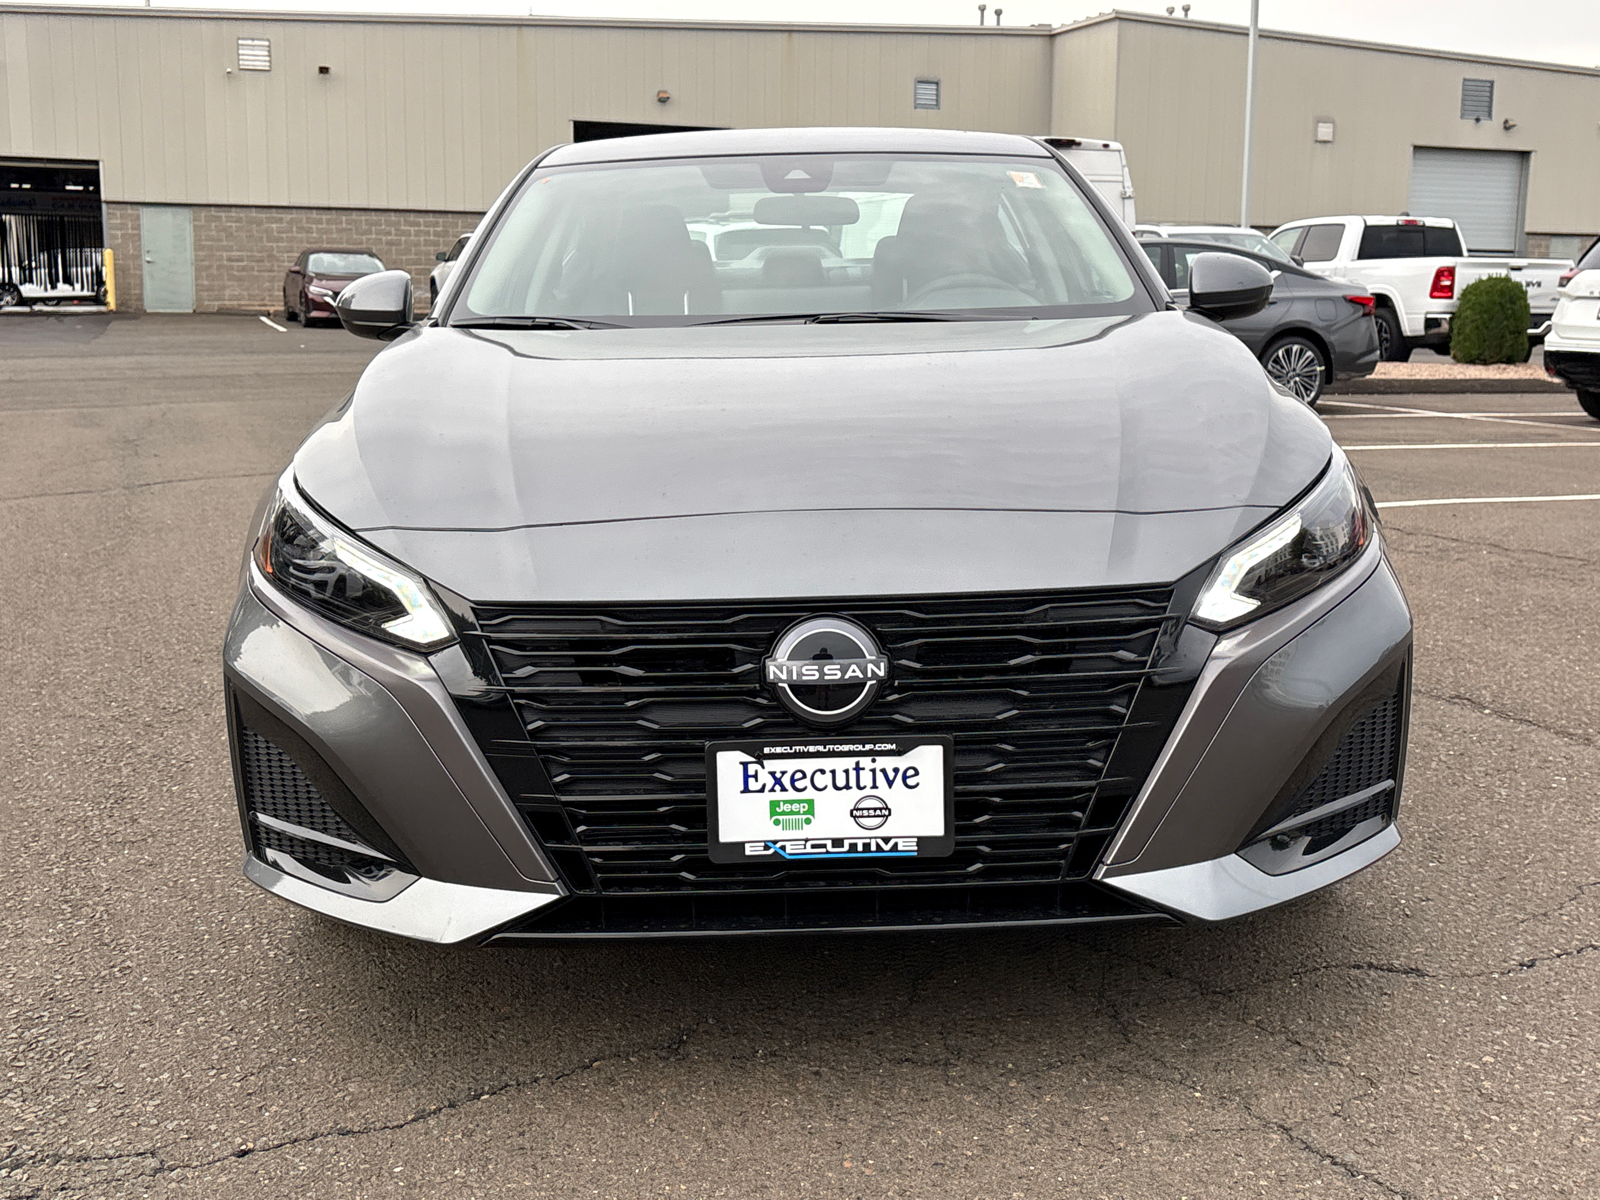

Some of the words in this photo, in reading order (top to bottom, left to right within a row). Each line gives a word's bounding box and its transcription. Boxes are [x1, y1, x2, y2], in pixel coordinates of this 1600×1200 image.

[769, 661, 885, 680] NISSAN
[763, 743, 897, 754] EXECUTIVEAUTOGROUP.COM
[739, 757, 920, 794] Executive
[775, 801, 809, 814] Jeep
[852, 809, 889, 817] NISSAN
[744, 837, 918, 857] EXECUTIVE
